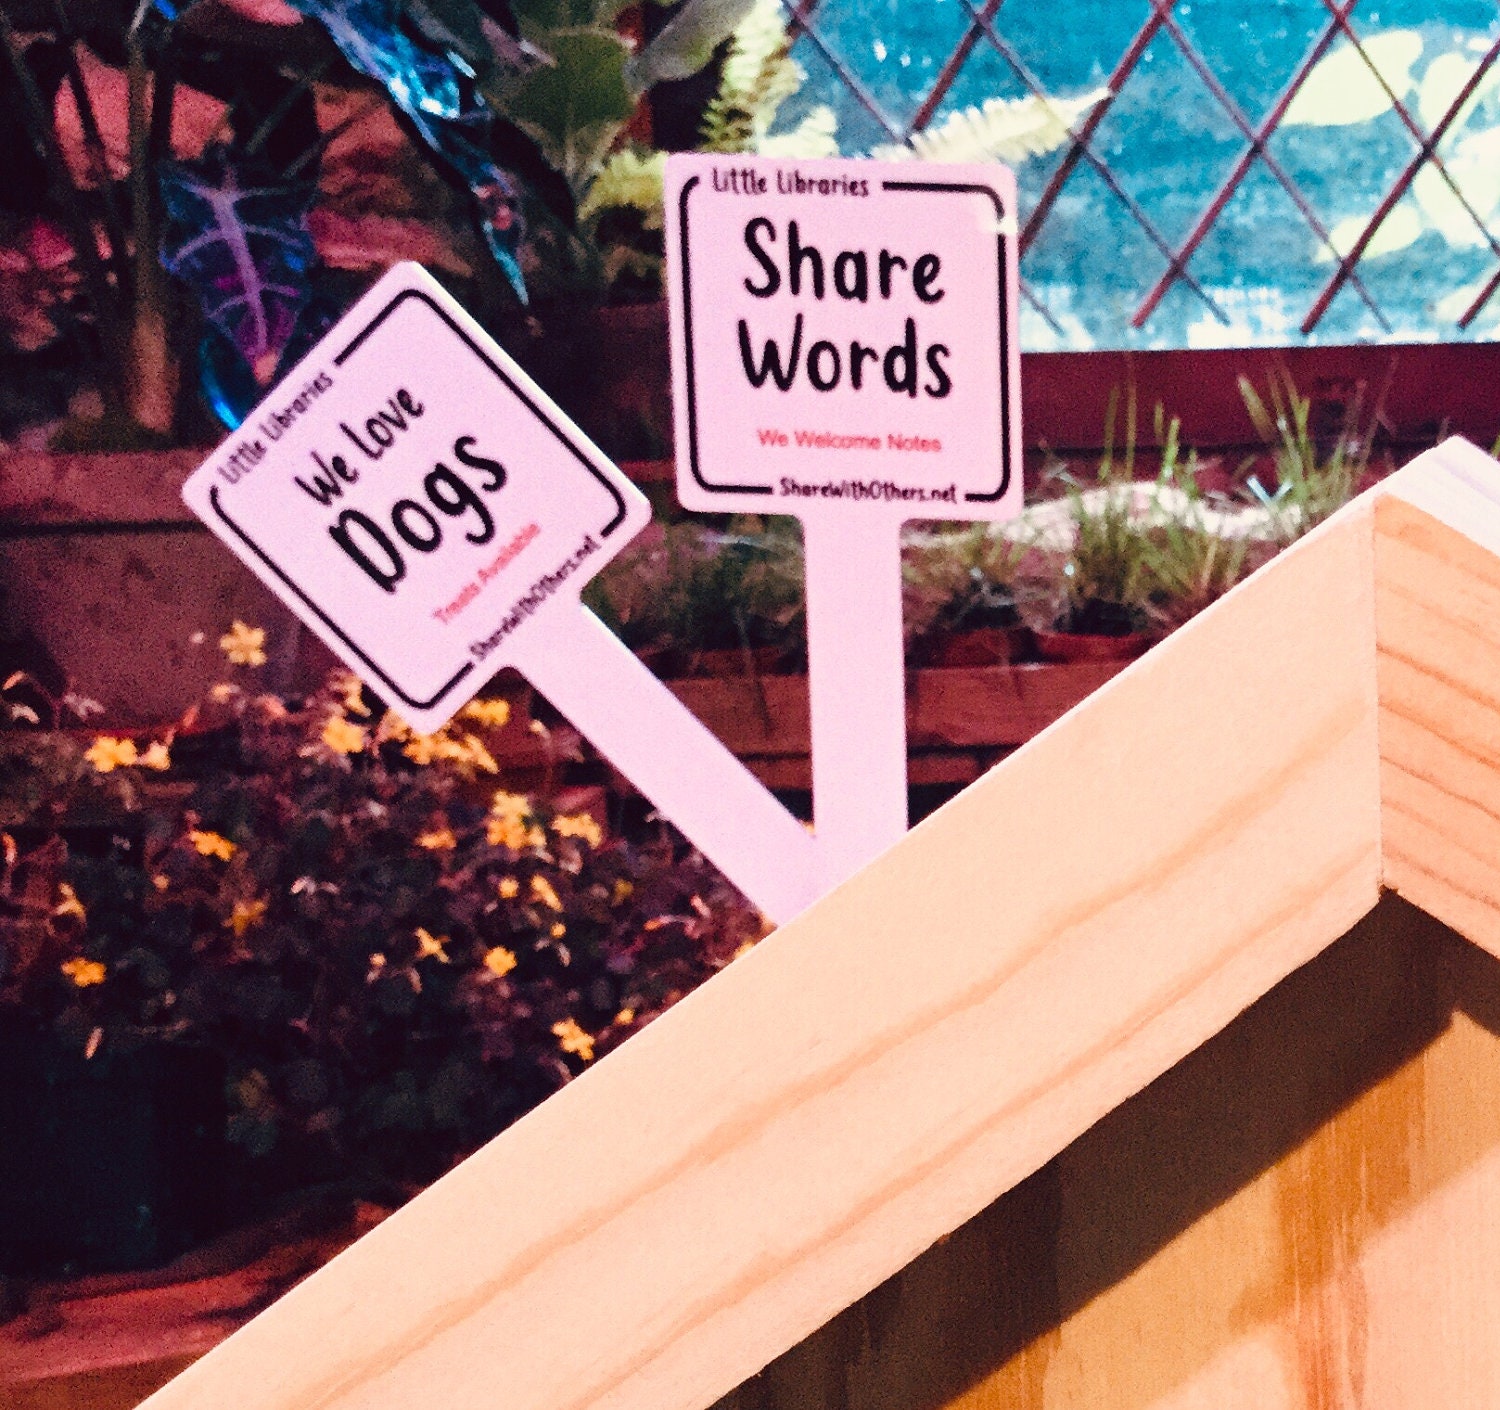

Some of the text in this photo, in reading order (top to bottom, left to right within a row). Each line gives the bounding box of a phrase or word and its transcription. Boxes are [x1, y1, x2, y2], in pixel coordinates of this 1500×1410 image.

[712, 167, 869, 198] Little Libraries
[743, 216, 945, 305] Share
[737, 312, 953, 399] Words
[217, 372, 333, 484] Little Libraries
[294, 388, 424, 506] We Love
[757, 429, 942, 452] We Welcome Notes
[328, 435, 508, 593] Dogs
